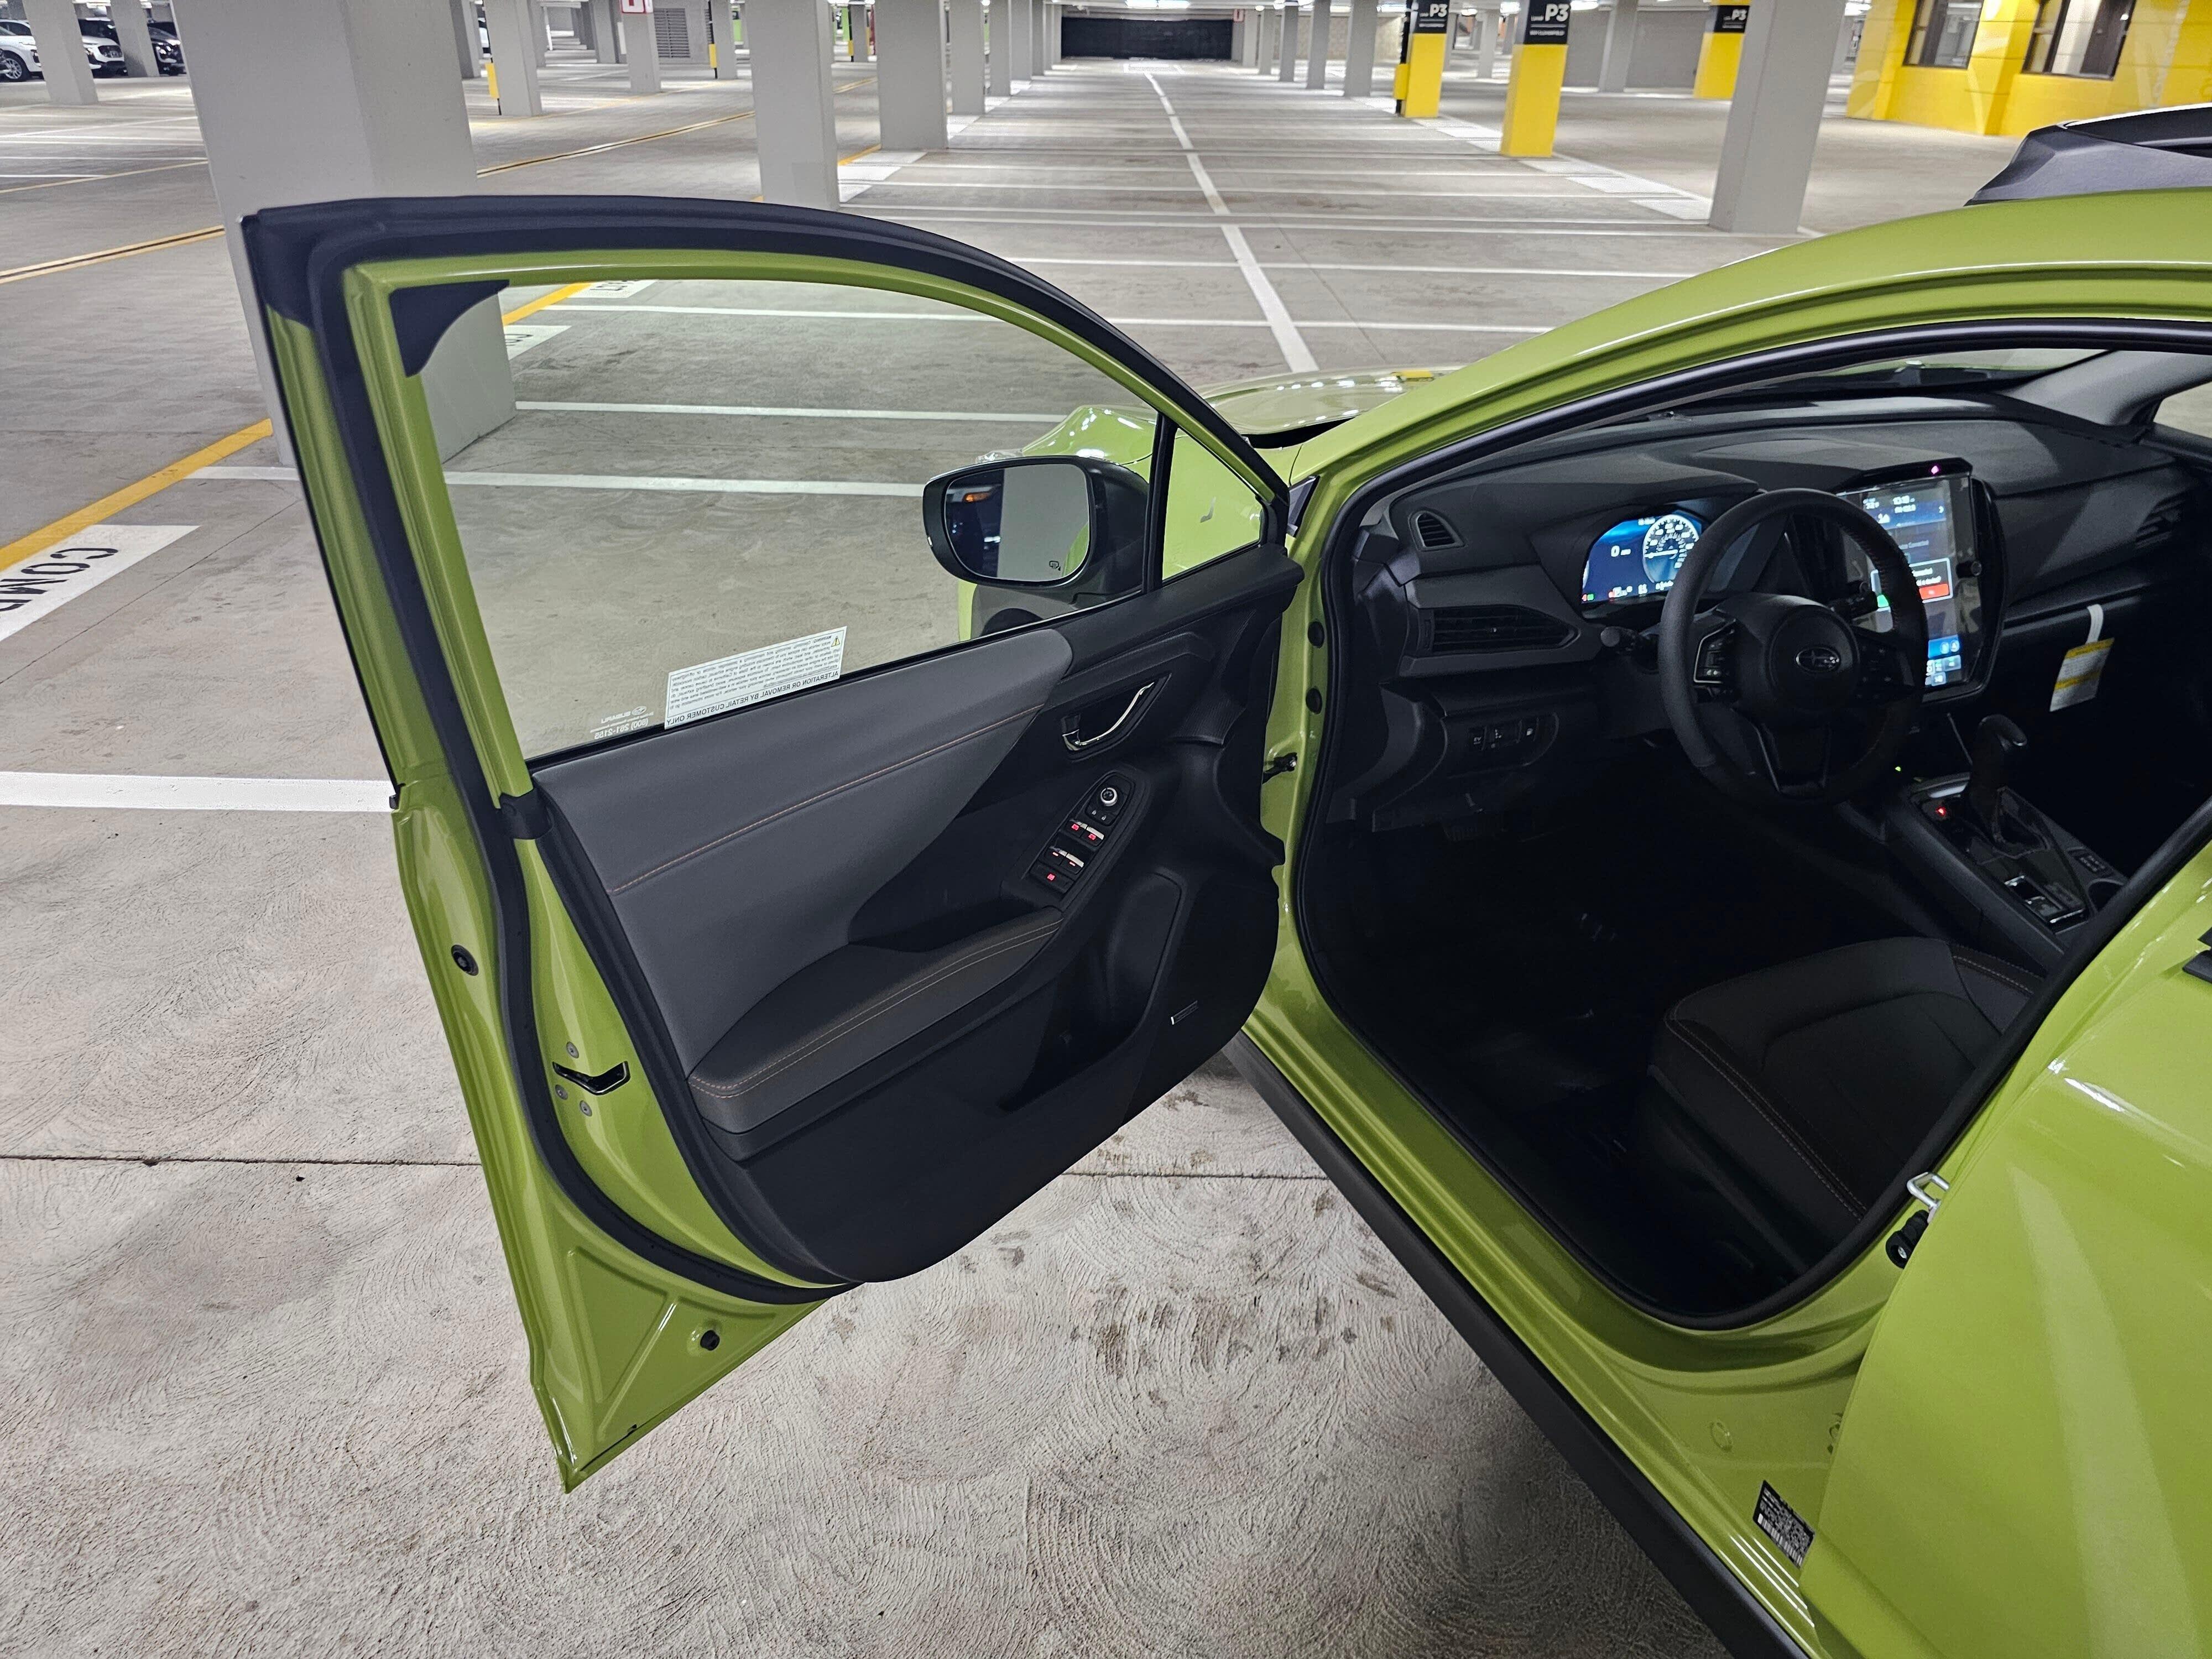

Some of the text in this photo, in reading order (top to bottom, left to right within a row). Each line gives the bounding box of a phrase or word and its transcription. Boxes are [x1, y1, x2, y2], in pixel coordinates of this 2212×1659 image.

[1430, 4, 1448, 17] P3
[1545, 3, 1570, 22] P3
[1731, 9, 1747, 20] P3
